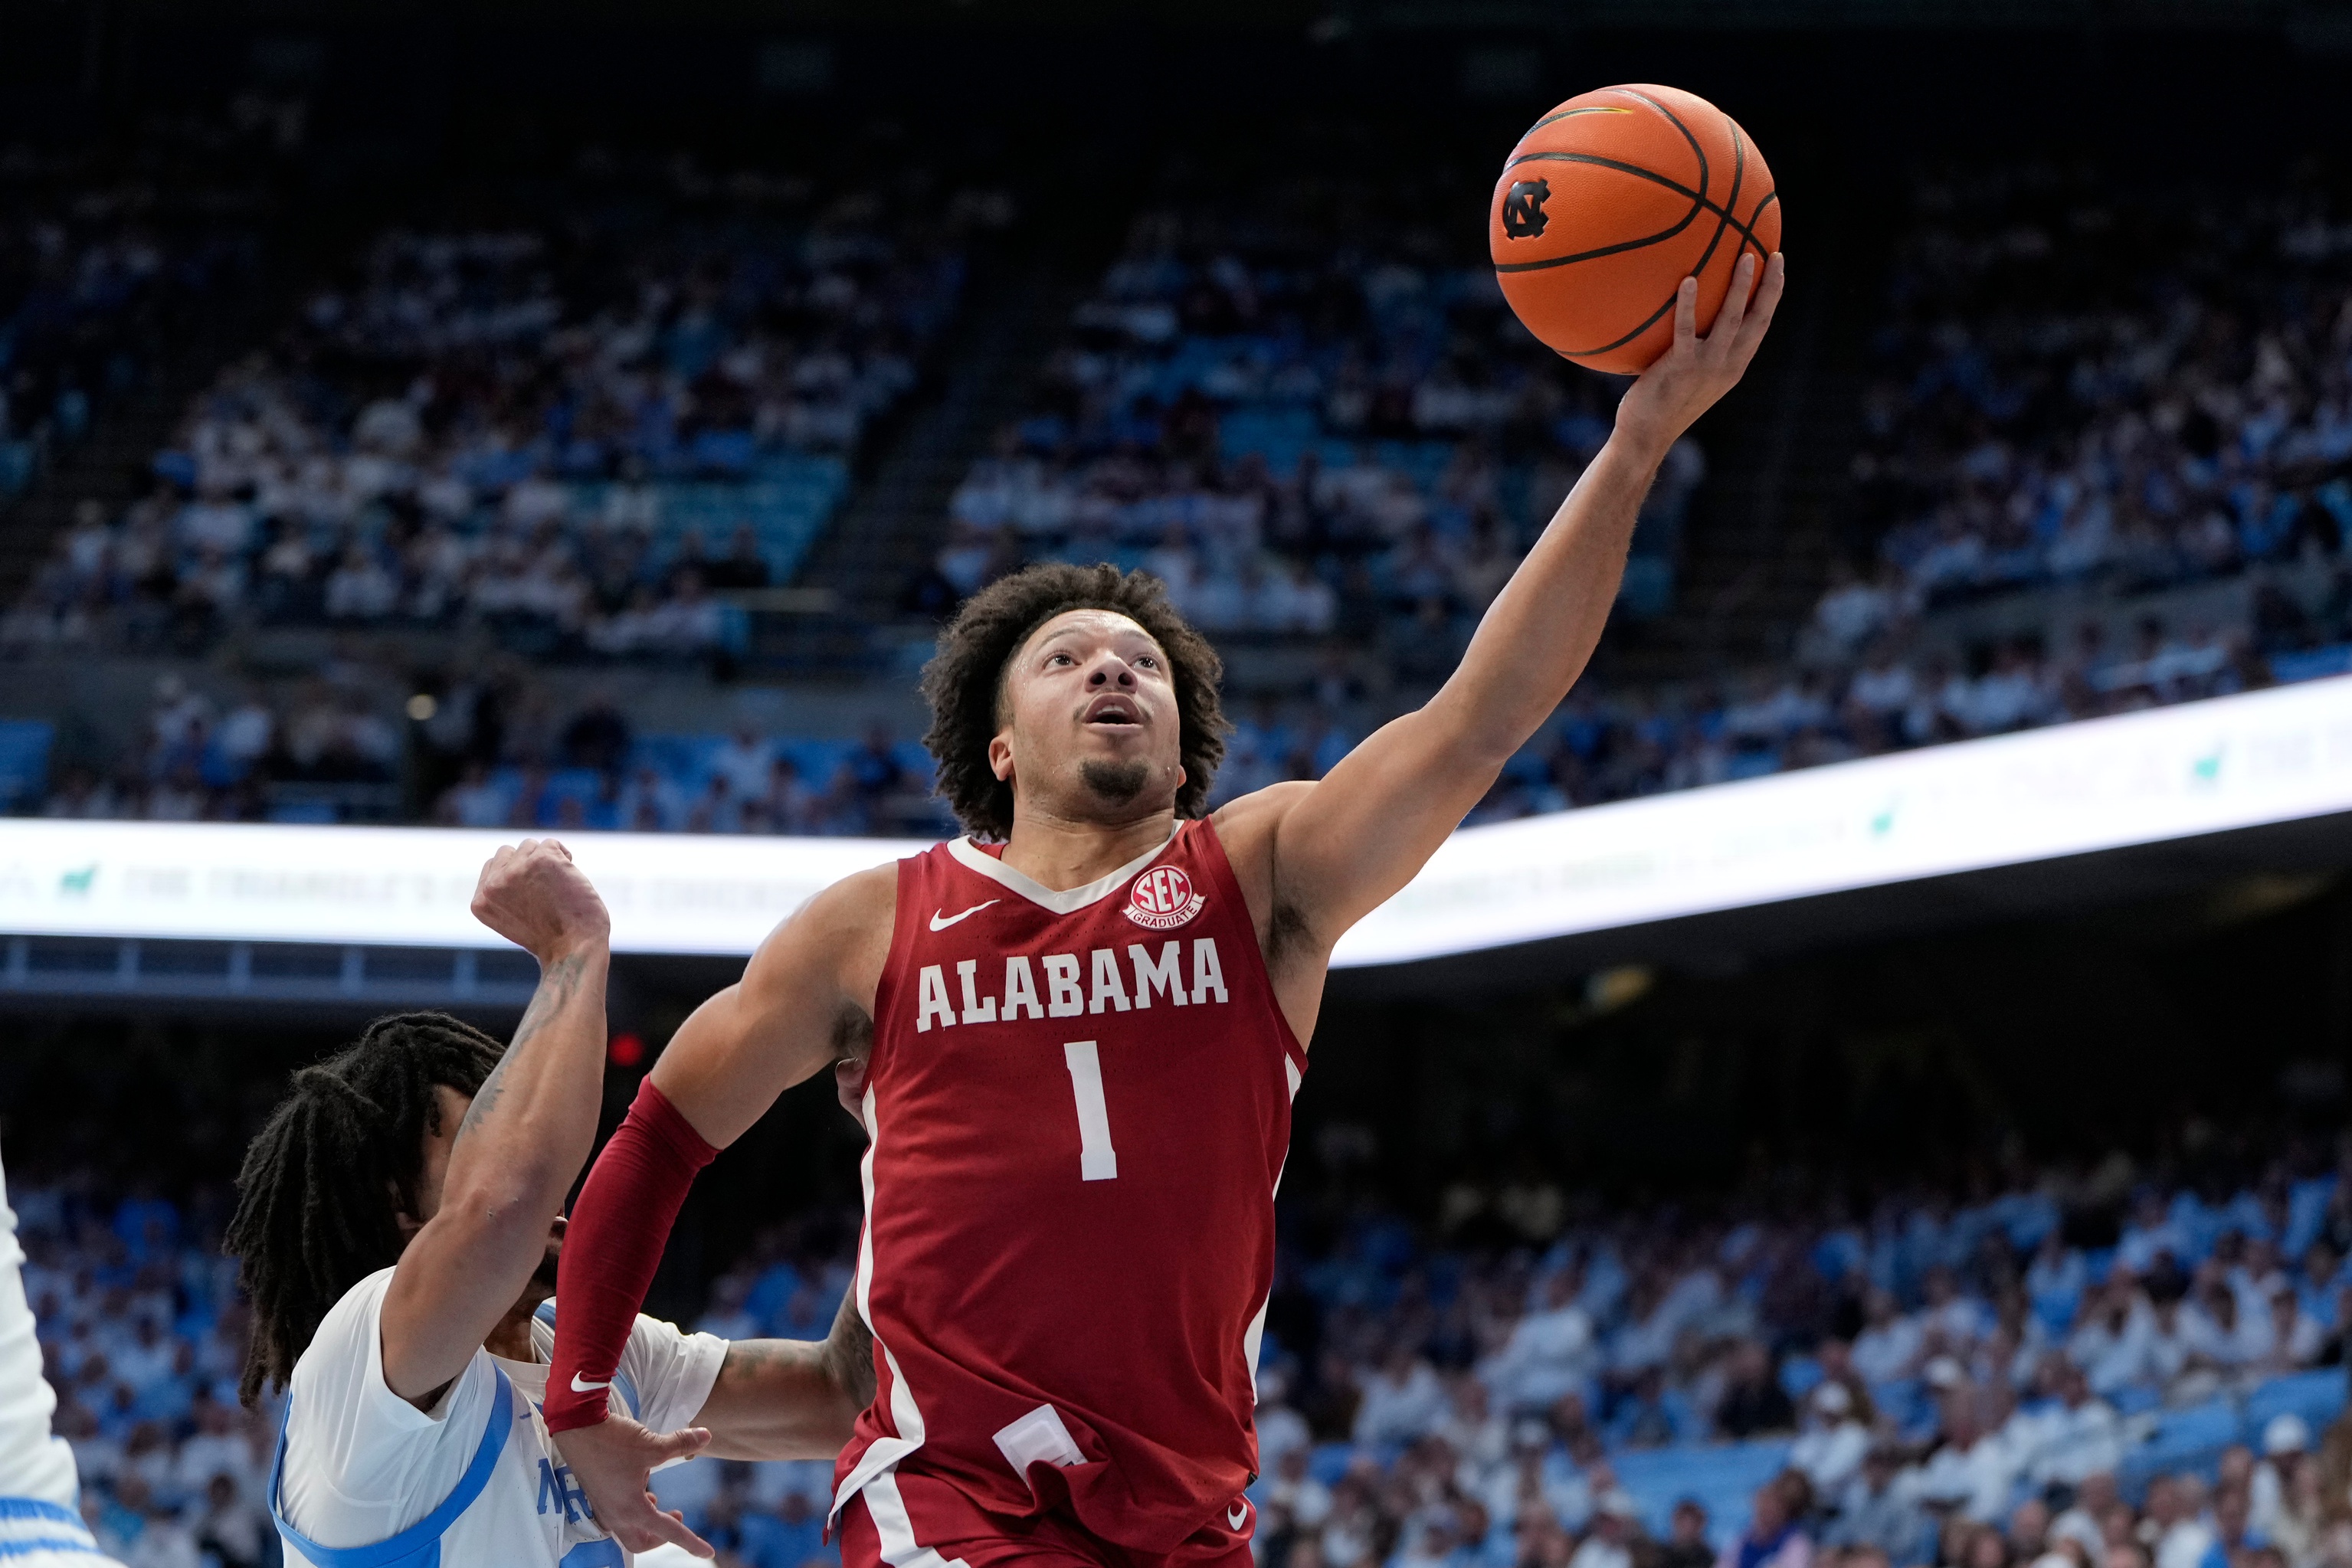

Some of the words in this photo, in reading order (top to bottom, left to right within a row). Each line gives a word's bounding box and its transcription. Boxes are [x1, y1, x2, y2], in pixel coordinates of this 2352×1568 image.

[1133, 905, 1197, 928] GRADUATE
[1135, 869, 1187, 912] SEC
[916, 938, 1229, 1033] ALABAMA
[1063, 1039, 1118, 1181] 1
